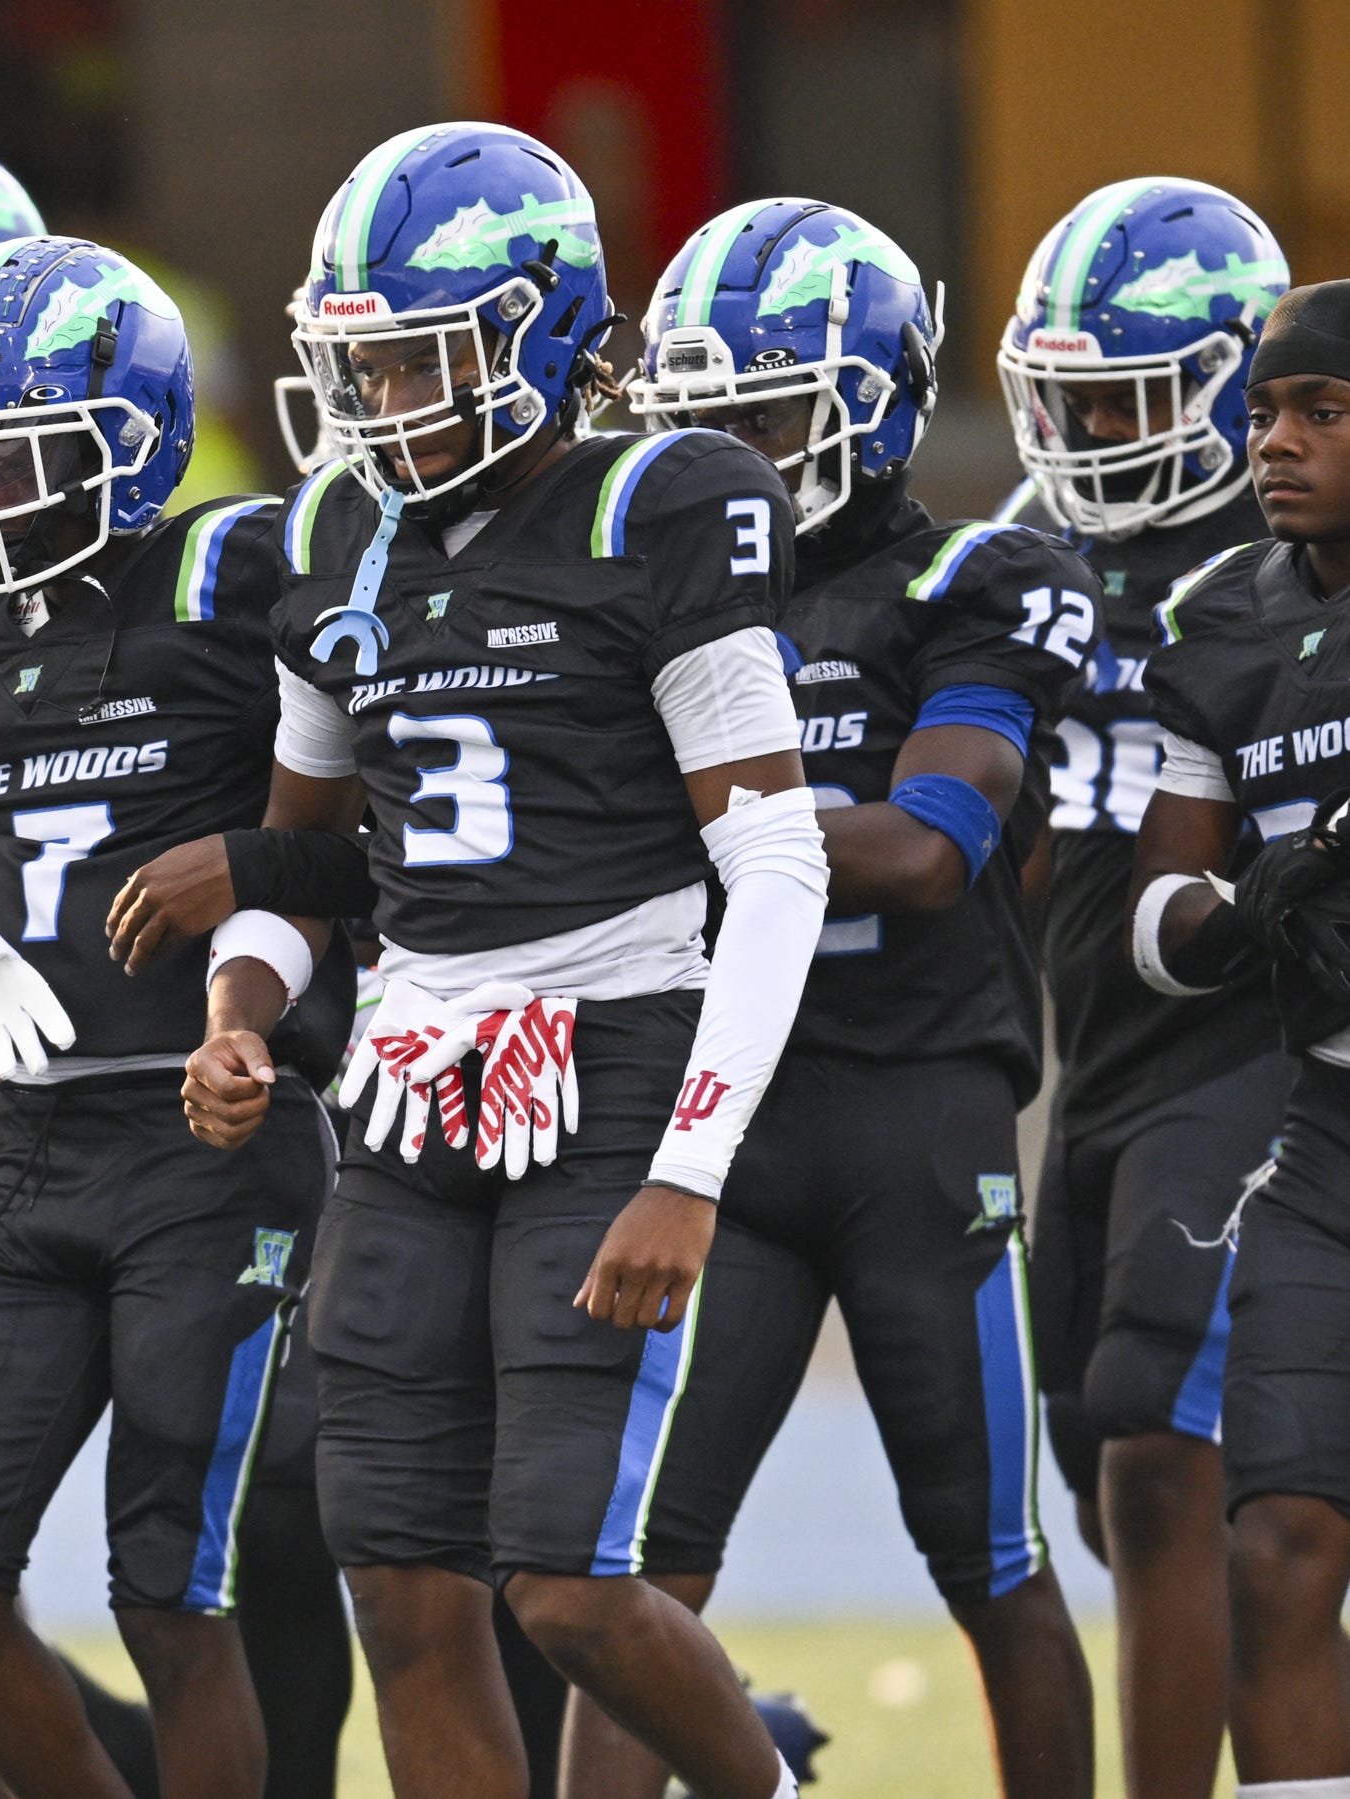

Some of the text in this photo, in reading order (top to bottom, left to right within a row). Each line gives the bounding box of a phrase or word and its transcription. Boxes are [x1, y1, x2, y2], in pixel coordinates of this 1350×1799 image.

[324, 298, 376, 316] Riddell
[750, 358, 795, 373] OAKLEY
[1035, 337, 1088, 352] Riddell
[725, 497, 771, 576] 3
[486, 621, 560, 648] IMPRESSIVE
[1009, 586, 1095, 669] 12
[21, 739, 169, 791] WOODS
[1235, 735, 1284, 781] THE
[386, 711, 514, 868] 3
[11, 799, 116, 943] 7
